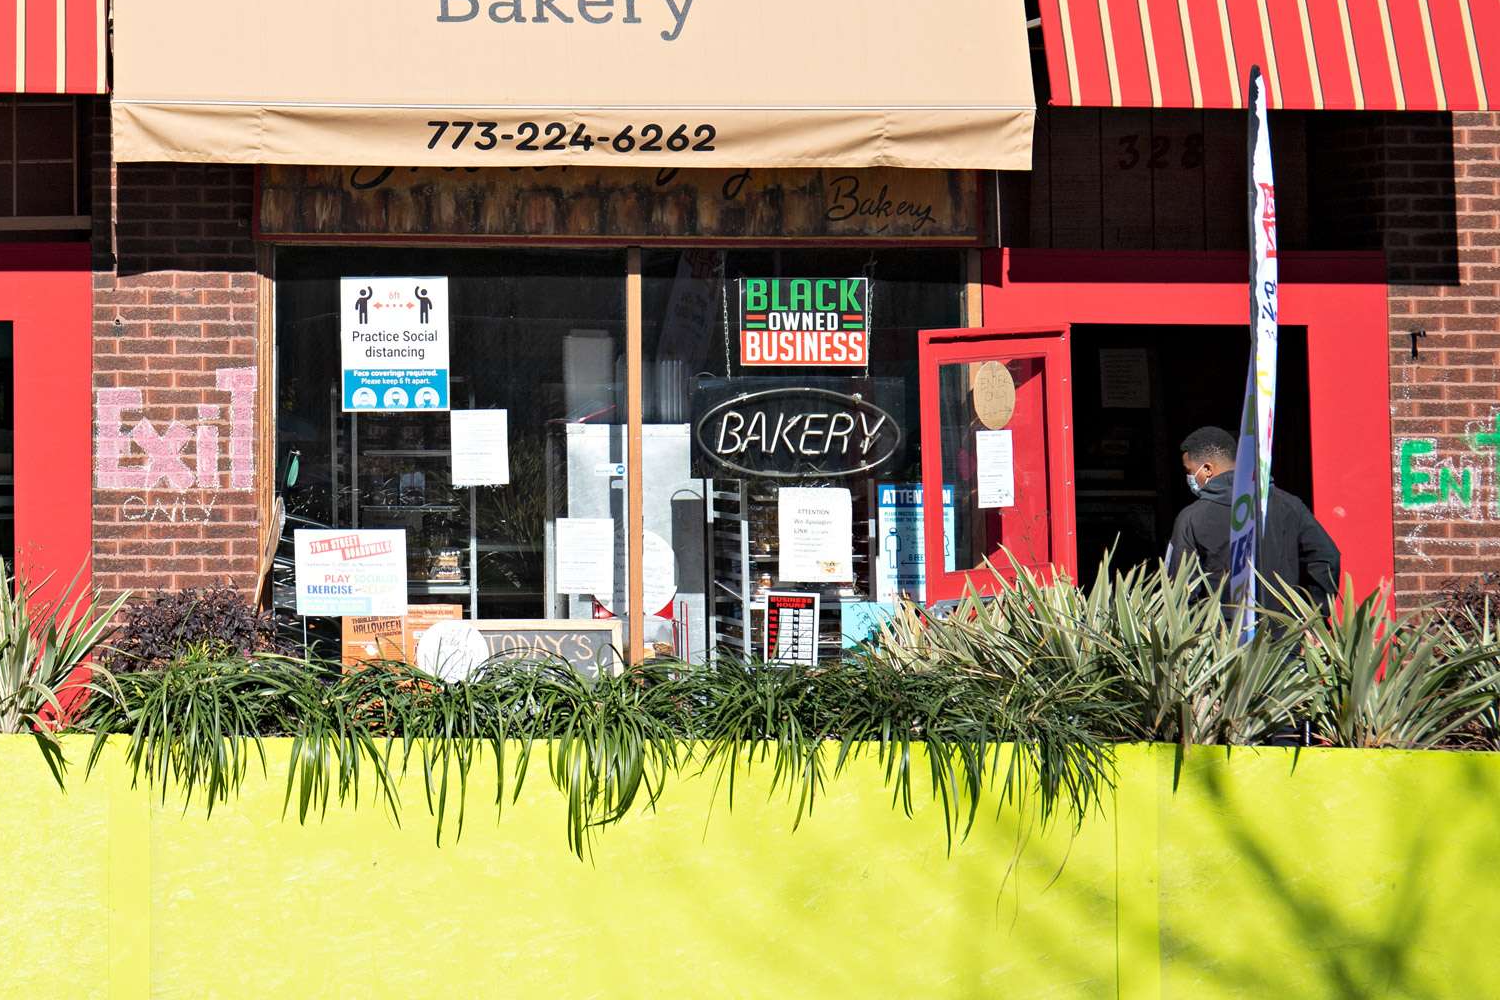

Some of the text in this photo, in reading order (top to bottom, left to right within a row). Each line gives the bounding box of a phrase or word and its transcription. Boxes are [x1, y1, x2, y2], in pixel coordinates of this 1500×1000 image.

[426, 120, 717, 153] 773-224-6262
[826, 175, 937, 224] Bakery
[746, 279, 863, 312] BLACK
[768, 312, 839, 331] OWNED
[352, 330, 438, 343] Practice Social
[365, 347, 425, 360] distancing
[746, 331, 863, 362] BUSINESS
[717, 412, 887, 454] BAKERY
[324, 574, 351, 583] PLAY
[307, 585, 353, 594] EXERCISE
[353, 620, 402, 634] HALLOWEEN
